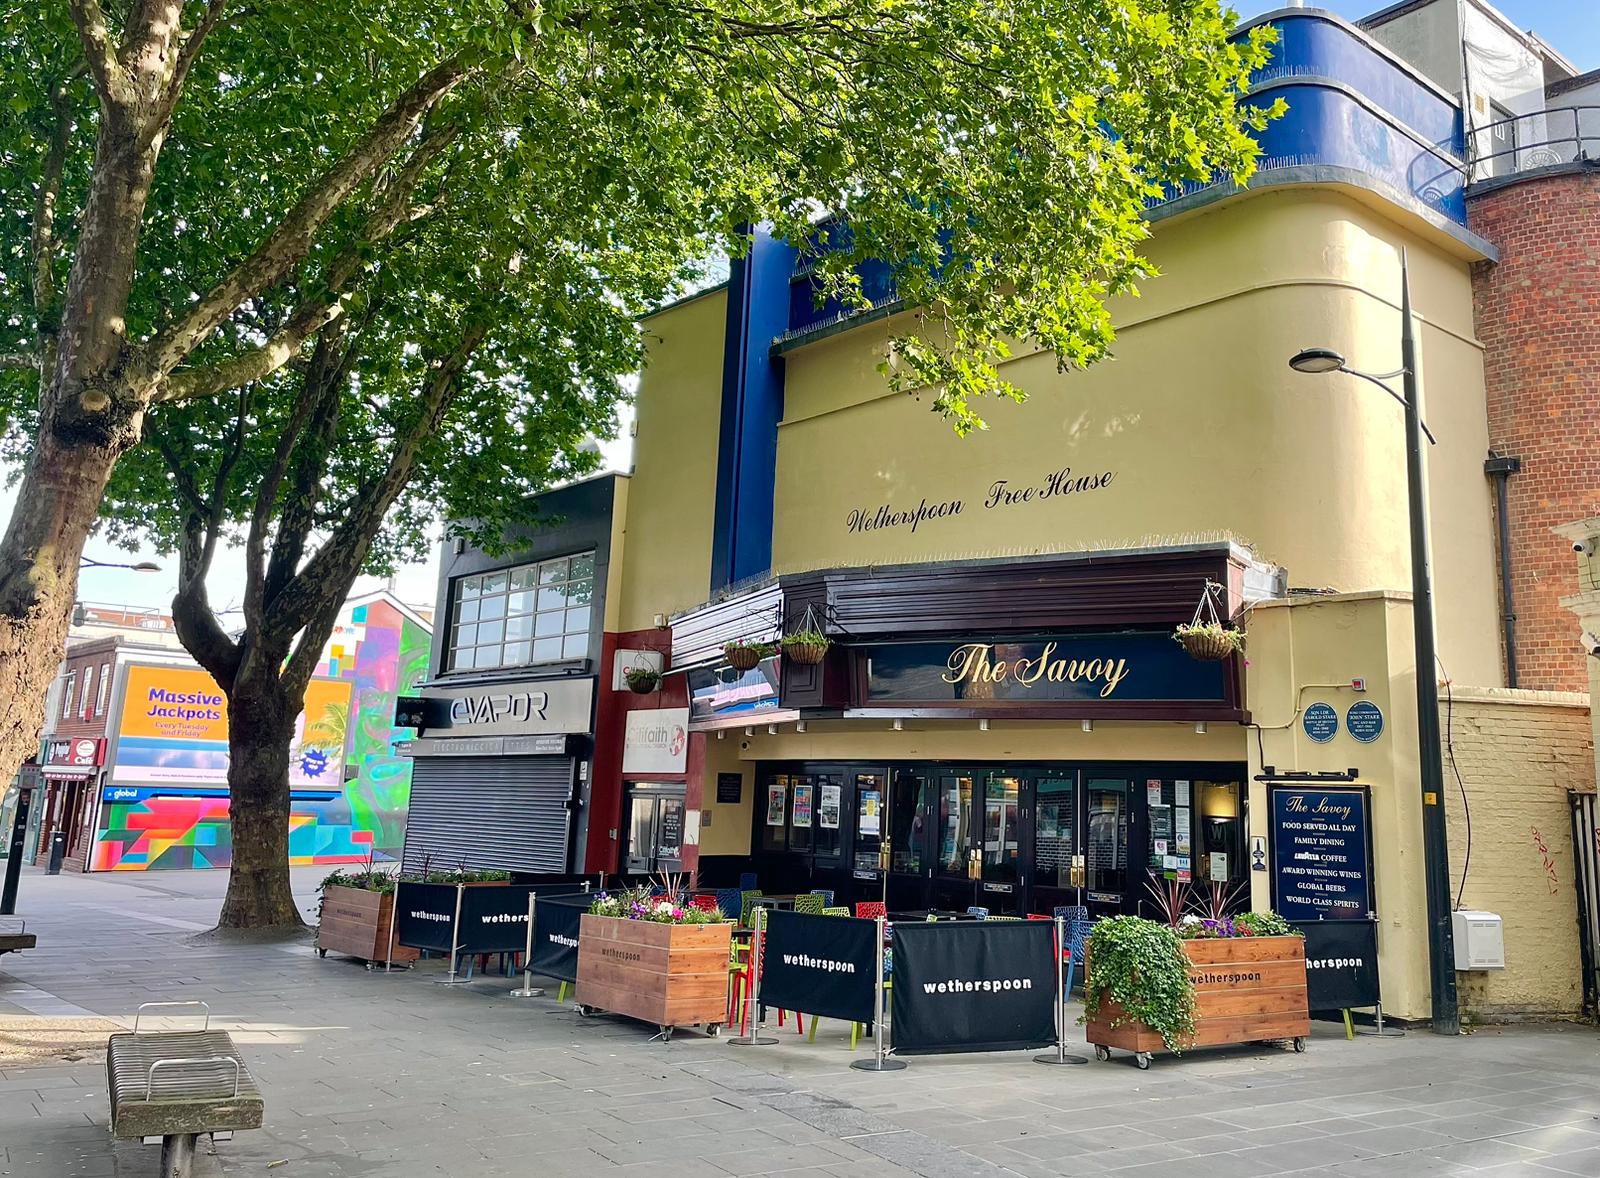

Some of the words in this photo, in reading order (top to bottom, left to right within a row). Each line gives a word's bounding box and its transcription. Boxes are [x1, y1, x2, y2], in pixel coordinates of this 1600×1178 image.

[846, 499, 966, 533] Wetherspoon
[985, 480, 1038, 508] Free
[1039, 467, 1118, 499] House
[941, 643, 1007, 684] The
[1013, 641, 1129, 698] Savoy
[148, 687, 222, 706] Massive
[147, 705, 220, 721] Jackpots
[155, 721, 176, 730] Every
[178, 722, 209, 731] Tuesday
[114, 789, 138, 799] global
[1285, 795, 1308, 812] The
[1311, 796, 1351, 821] Savoy
[1282, 821, 1301, 829] FOOD
[1303, 822, 1328, 831] SERVED
[1342, 824, 1356, 832] DAY
[1294, 836, 1318, 845] FAMILY
[1319, 838, 1345, 846] DINING
[1320, 854, 1347, 862] COFFEE
[1282, 866, 1306, 875] AWARD
[1306, 868, 1338, 877] WINNING
[1339, 870, 1361, 879] WINES
[1297, 882, 1324, 890] GLOBAL
[1325, 884, 1346, 892] BEERS
[1286, 895, 1311, 904] WORLD
[1312, 897, 1332, 906] CLASS
[1333, 900, 1360, 908] SPIRITS
[410, 910, 451, 922] wetherspoon
[481, 913, 530, 924] wethers
[549, 933, 580, 949] wetherspo
[601, 947, 641, 963] wetherspoon
[783, 952, 855, 974] wetherspoon
[1305, 957, 1363, 969] herspoon
[923, 976, 1032, 994] wetherspoon
